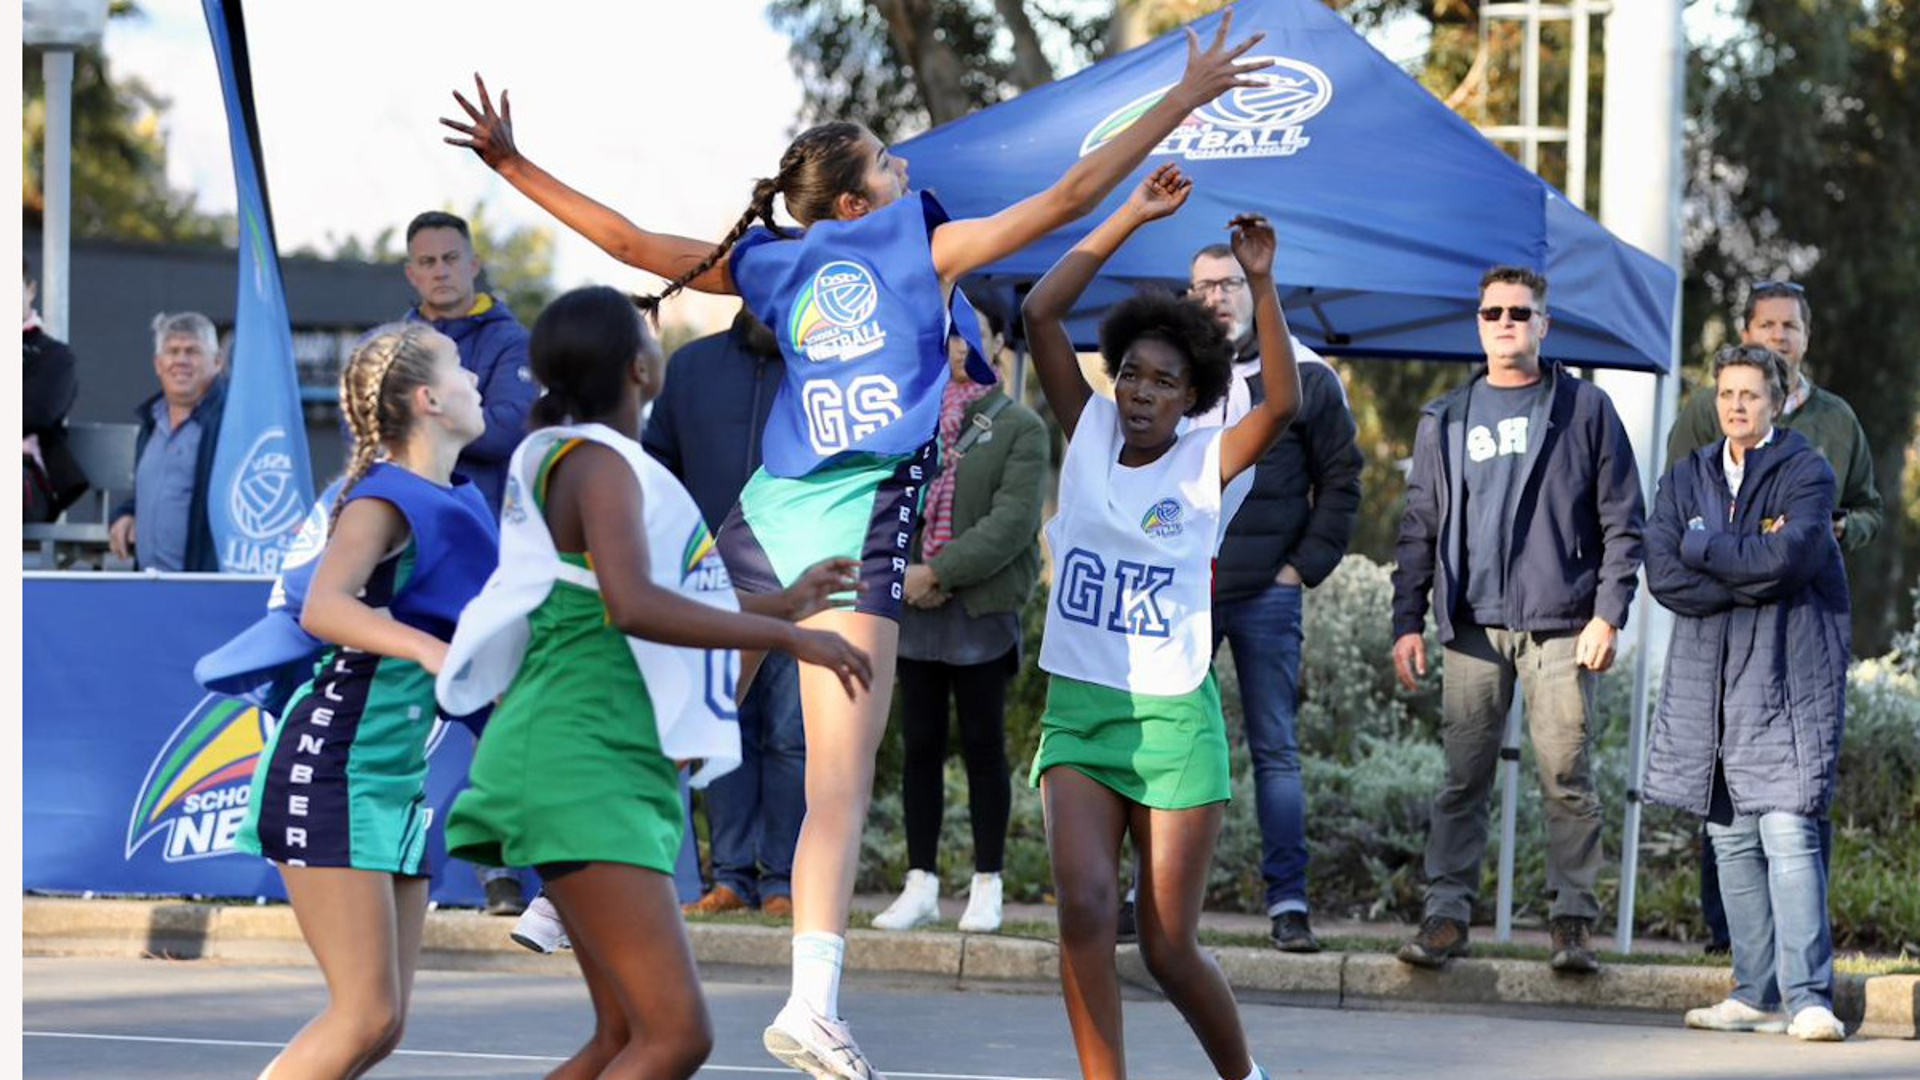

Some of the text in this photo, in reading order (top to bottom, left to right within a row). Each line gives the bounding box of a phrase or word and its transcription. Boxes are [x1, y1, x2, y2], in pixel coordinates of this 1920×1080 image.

[1154, 125, 1307, 154] ETBALL
[802, 374, 903, 455] GS
[1056, 546, 1176, 637] GK
[285, 645, 364, 868] LLENBER
[169, 806, 250, 856] NE
[183, 784, 251, 814] SCHO
